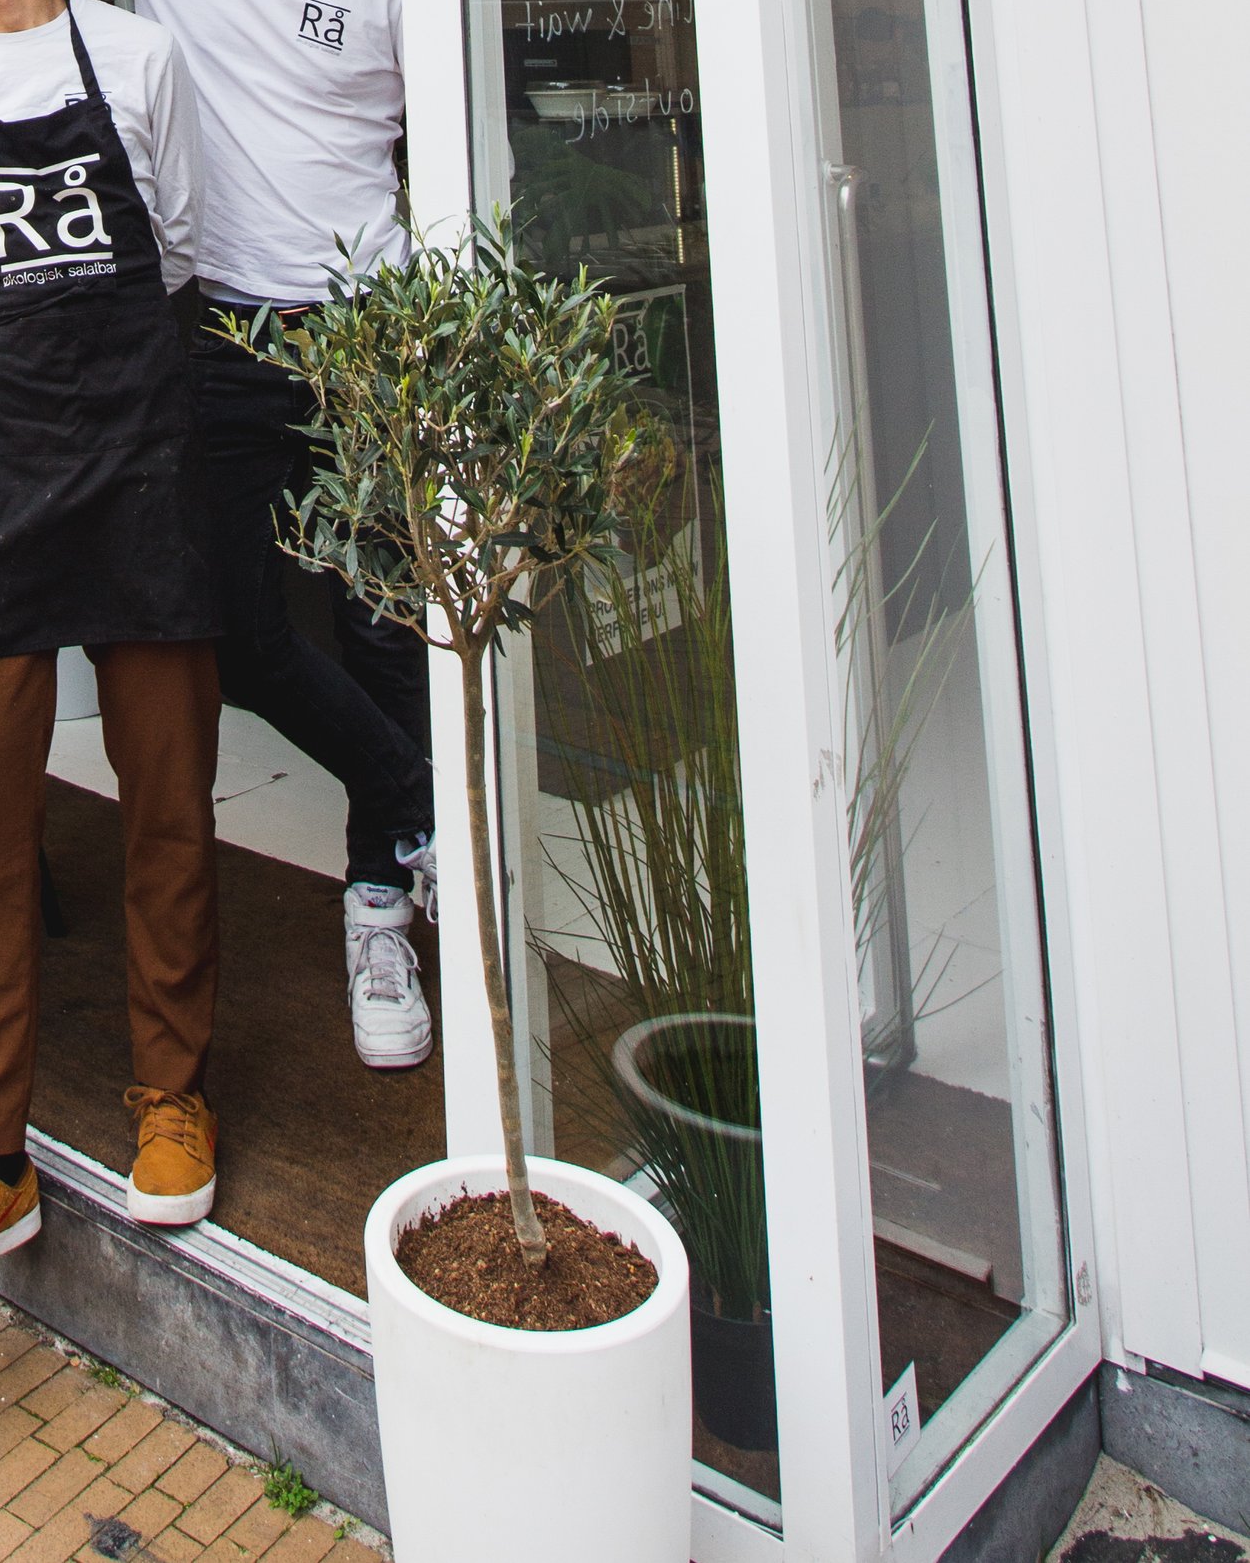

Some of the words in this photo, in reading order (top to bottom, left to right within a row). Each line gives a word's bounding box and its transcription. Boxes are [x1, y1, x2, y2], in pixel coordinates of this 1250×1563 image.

[299, 2, 344, 46] Rå
[2, 267, 64, 288] økologisk
[68, 262, 117, 277] salatbar
[890, 1397, 910, 1442] Rå
